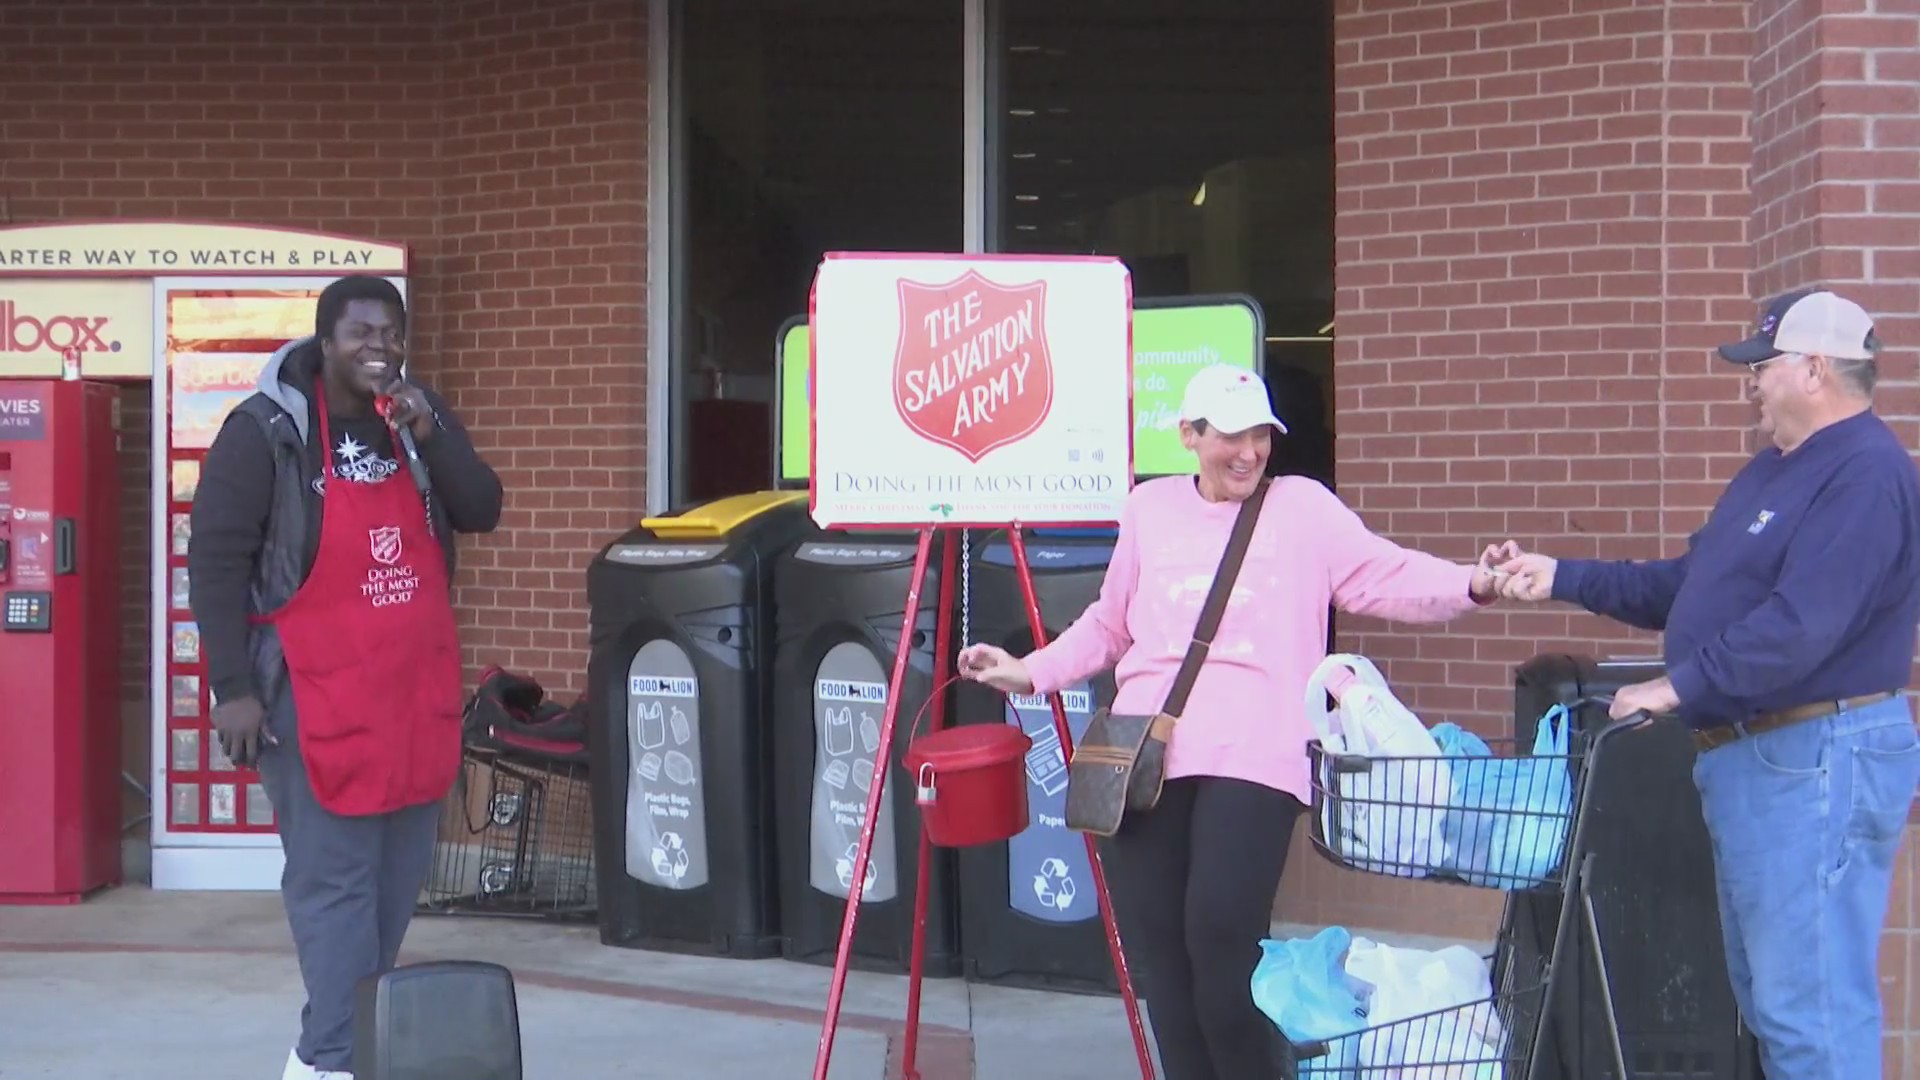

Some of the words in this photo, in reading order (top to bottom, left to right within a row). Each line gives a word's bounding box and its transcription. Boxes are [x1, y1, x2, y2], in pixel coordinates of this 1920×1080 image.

[84, 249, 136, 265] WAY
[148, 249, 178, 265] TO
[190, 249, 275, 265] WATCH
[288, 250, 301, 265] &
[313, 249, 374, 265] PLAY
[924, 290, 983, 348] THE
[904, 299, 1034, 412] SALVATION
[952, 352, 1030, 437] ARMY
[834, 471, 916, 493] DOING
[927, 474, 964, 493] THE
[973, 474, 1035, 493] MOST
[1043, 473, 1113, 493] GOOD
[1060, 502, 1111, 511] DONATION
[1037, 551, 1066, 560] Paper
[368, 565, 412, 582] DOING
[360, 581, 385, 596] THE
[388, 577, 420, 592] MOST
[372, 590, 413, 607] GOOD
[633, 679, 658, 693] FOOD
[672, 680, 693, 695] LION
[821, 682, 847, 697] FOOD
[862, 684, 883, 700] LION
[644, 792, 670, 804] Plastic
[830, 800, 858, 813] Plastic
[668, 806, 689, 820] Wrap
